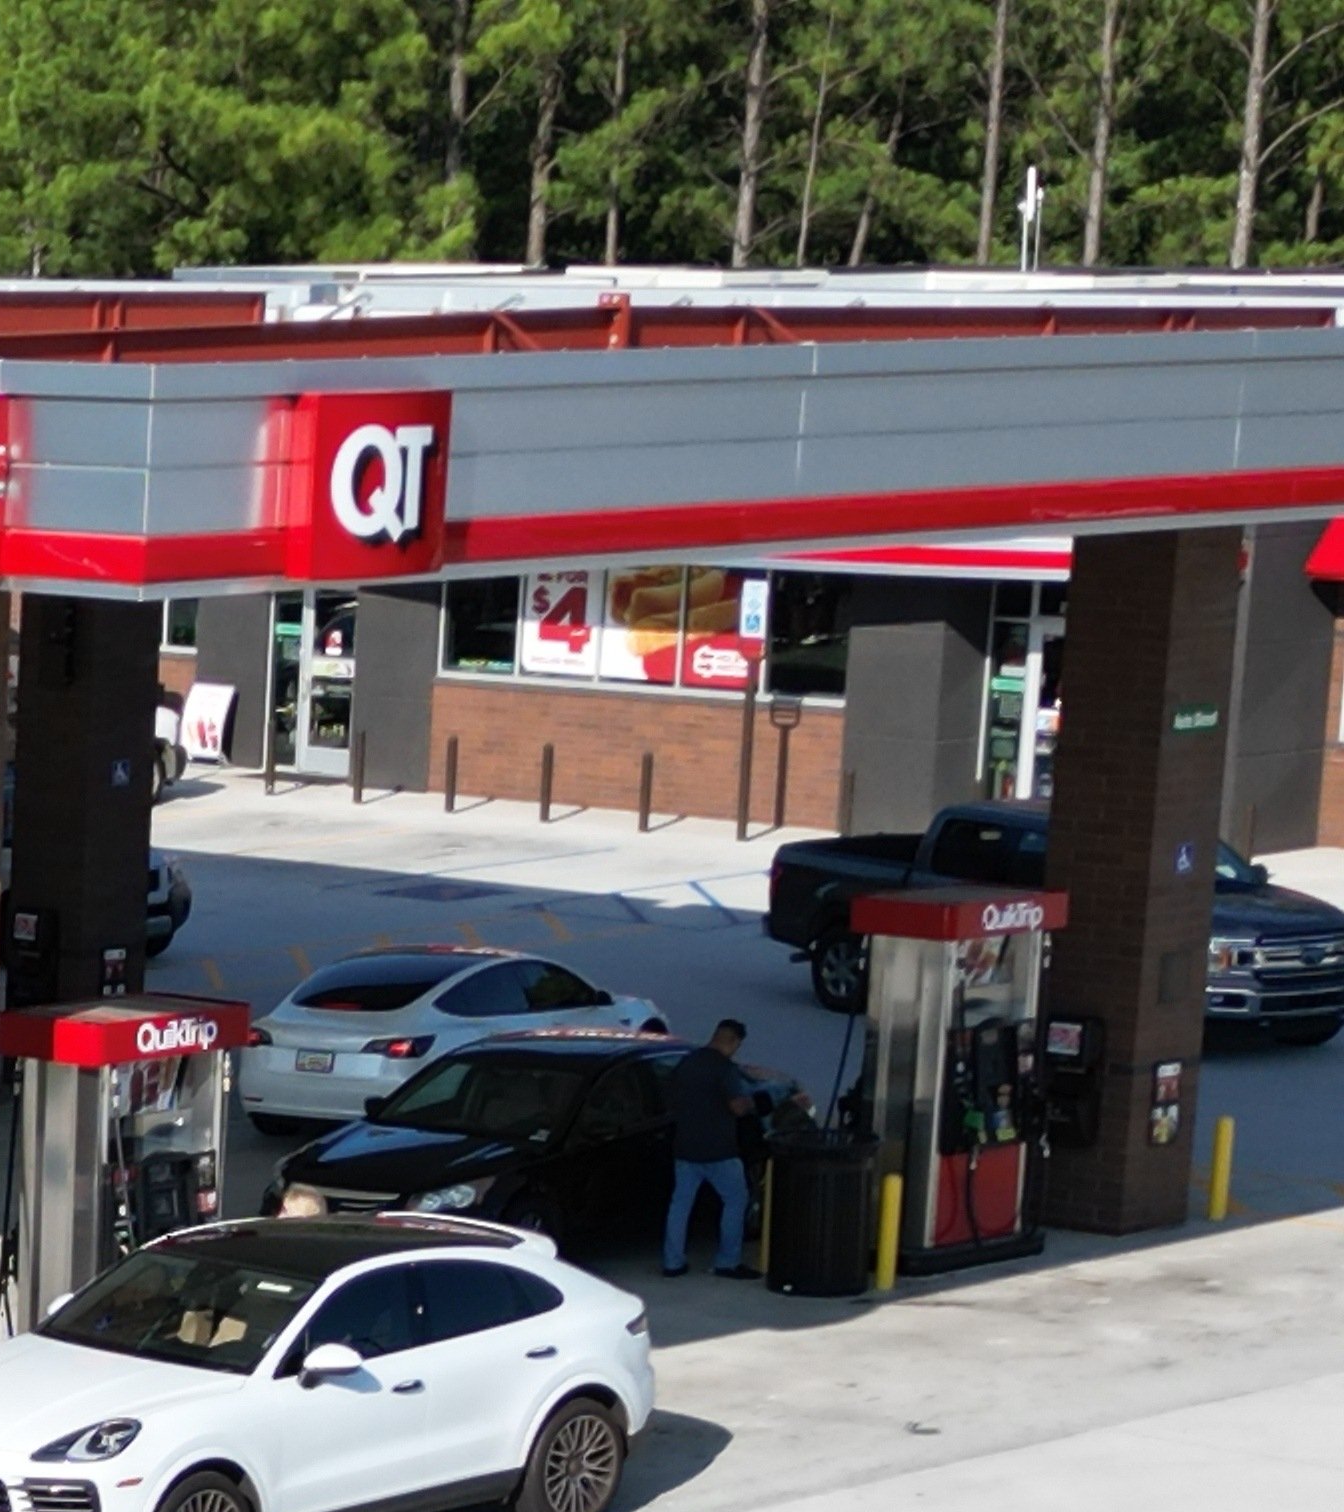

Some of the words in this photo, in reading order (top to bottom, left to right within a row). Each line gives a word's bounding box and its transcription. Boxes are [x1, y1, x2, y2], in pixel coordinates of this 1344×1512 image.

[330, 424, 433, 542] QT
[983, 901, 1043, 931] QuikTrip
[137, 1017, 217, 1053] QuikTrip
